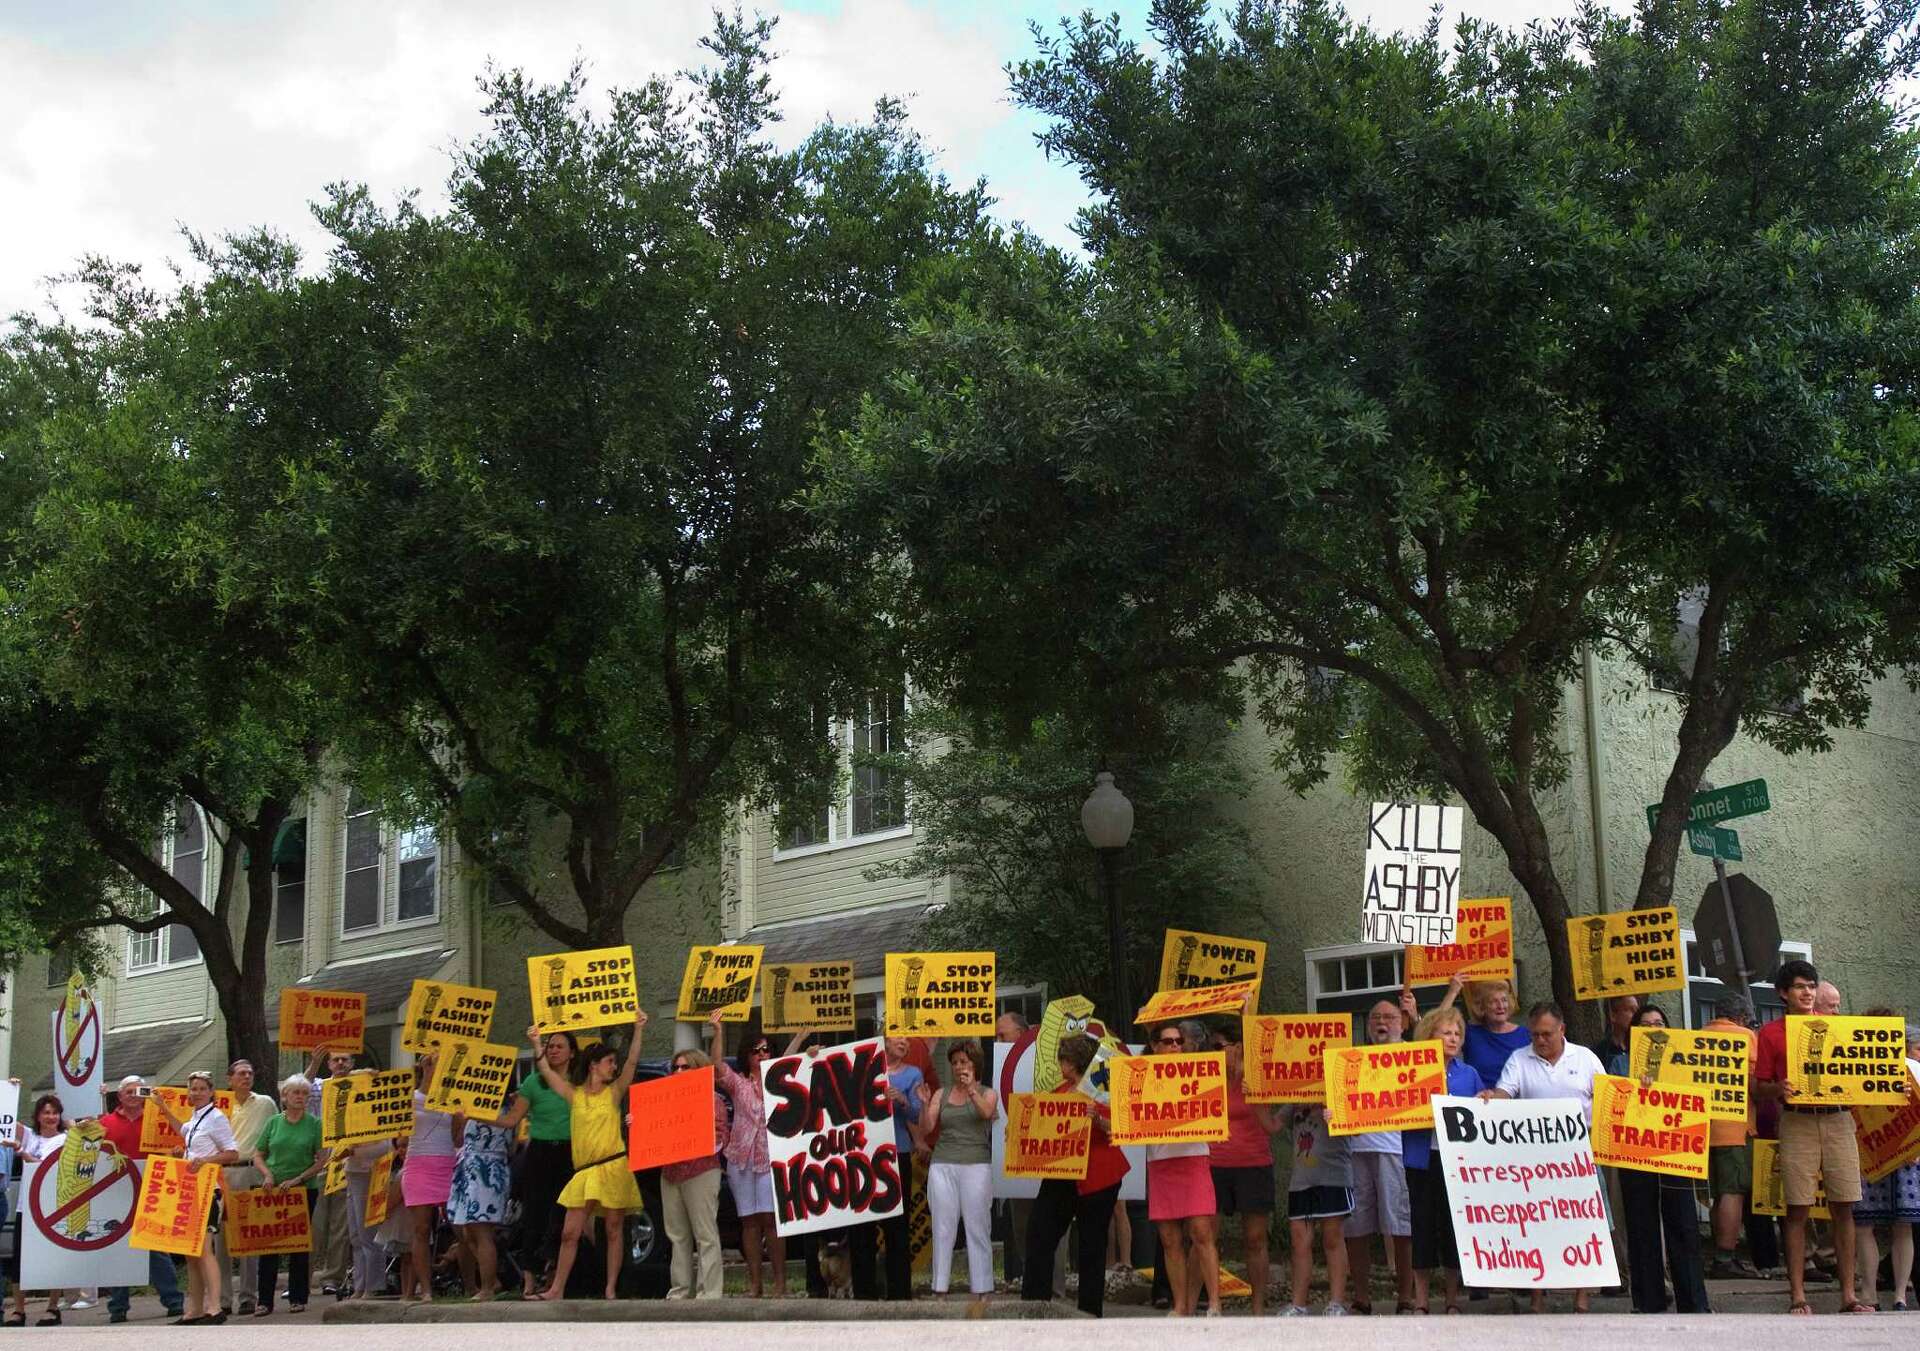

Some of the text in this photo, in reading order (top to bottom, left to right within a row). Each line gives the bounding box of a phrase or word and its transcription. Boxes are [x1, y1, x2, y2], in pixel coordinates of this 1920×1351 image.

[1368, 801, 1461, 854] KILL
[1403, 853, 1428, 864] THE
[1364, 864, 1460, 914] ASHBY
[1457, 906, 1505, 923] OWER
[1626, 911, 1673, 928] STOP
[1362, 912, 1453, 945] MONSTER
[1470, 924, 1486, 938] of
[1609, 929, 1675, 949] ASHBY
[1201, 943, 1256, 964] TOWER
[1424, 942, 1508, 962] TRAFFIC
[1626, 947, 1675, 965] HIGH
[587, 958, 631, 973] STOP
[714, 955, 754, 969] TOWER
[1220, 963, 1236, 975] of
[725, 970, 738, 983] of
[810, 967, 850, 978] STOP
[946, 965, 993, 977] STOP
[1634, 966, 1676, 982] RISE
[569, 972, 632, 990] ASHBY
[792, 980, 850, 992] ASHBY
[926, 981, 992, 993] ASHBY
[546, 987, 635, 1008] HIGHRISE.
[693, 987, 747, 1003] TRAFFIC
[811, 993, 851, 1004] HIGH
[900, 997, 993, 1009] HIGHRISE.
[313, 997, 361, 1010] TOWER
[456, 997, 492, 1011] STOP
[599, 1000, 636, 1014] ORG
[816, 1006, 852, 1017] RISE
[331, 1010, 346, 1021] of
[438, 1008, 489, 1025] ASHBY
[954, 1012, 993, 1025] ORG
[295, 1023, 361, 1038] TRAFFIC
[417, 1018, 486, 1039] HIGHRISE.
[1283, 1022, 1347, 1039] TOWER
[1852, 1029, 1903, 1042] STOP
[1309, 1040, 1326, 1056] of
[1694, 1037, 1746, 1052] STOP
[1831, 1046, 1903, 1059] ASHBY
[480, 1054, 513, 1068] STOP
[1368, 1049, 1438, 1069] TOWER
[1670, 1052, 1745, 1069] ASHBY
[462, 1066, 509, 1082] ASHBY
[1153, 1060, 1221, 1079] TOWER
[1398, 1068, 1416, 1084] of
[1804, 1062, 1905, 1076] HIGHRISE.
[371, 1073, 412, 1088] STOP
[441, 1077, 503, 1096] HIGHRISE.
[1693, 1071, 1744, 1086] HIGH
[1862, 1080, 1905, 1093] ORG
[354, 1086, 412, 1103] ASHBY
[764, 1042, 893, 1138] SAVE
[1180, 1080, 1199, 1096] of
[1711, 1089, 1745, 1103] ISE
[371, 1099, 412, 1114] HIGH
[473, 1096, 500, 1110] ORG
[1638, 1088, 1705, 1113] TOWER
[1039, 1101, 1087, 1117] TOWER
[1131, 1100, 1222, 1121] TRAFFIC
[377, 1112, 413, 1126] RISE
[1056, 1119, 1071, 1134] of
[1442, 1106, 1587, 1145] BUCKHEADS
[1663, 1113, 1682, 1127] of
[809, 1122, 868, 1161] OUR
[1020, 1138, 1085, 1157] TRAFFIC
[1612, 1124, 1705, 1155] TRAFFIC
[144, 1160, 168, 1214] TOWER
[771, 1143, 902, 1225] HOODS
[254, 1193, 304, 1208] TOWER
[275, 1208, 289, 1220] of
[240, 1221, 307, 1239] TRAFFIC
[1563, 1232, 1603, 1266] out
